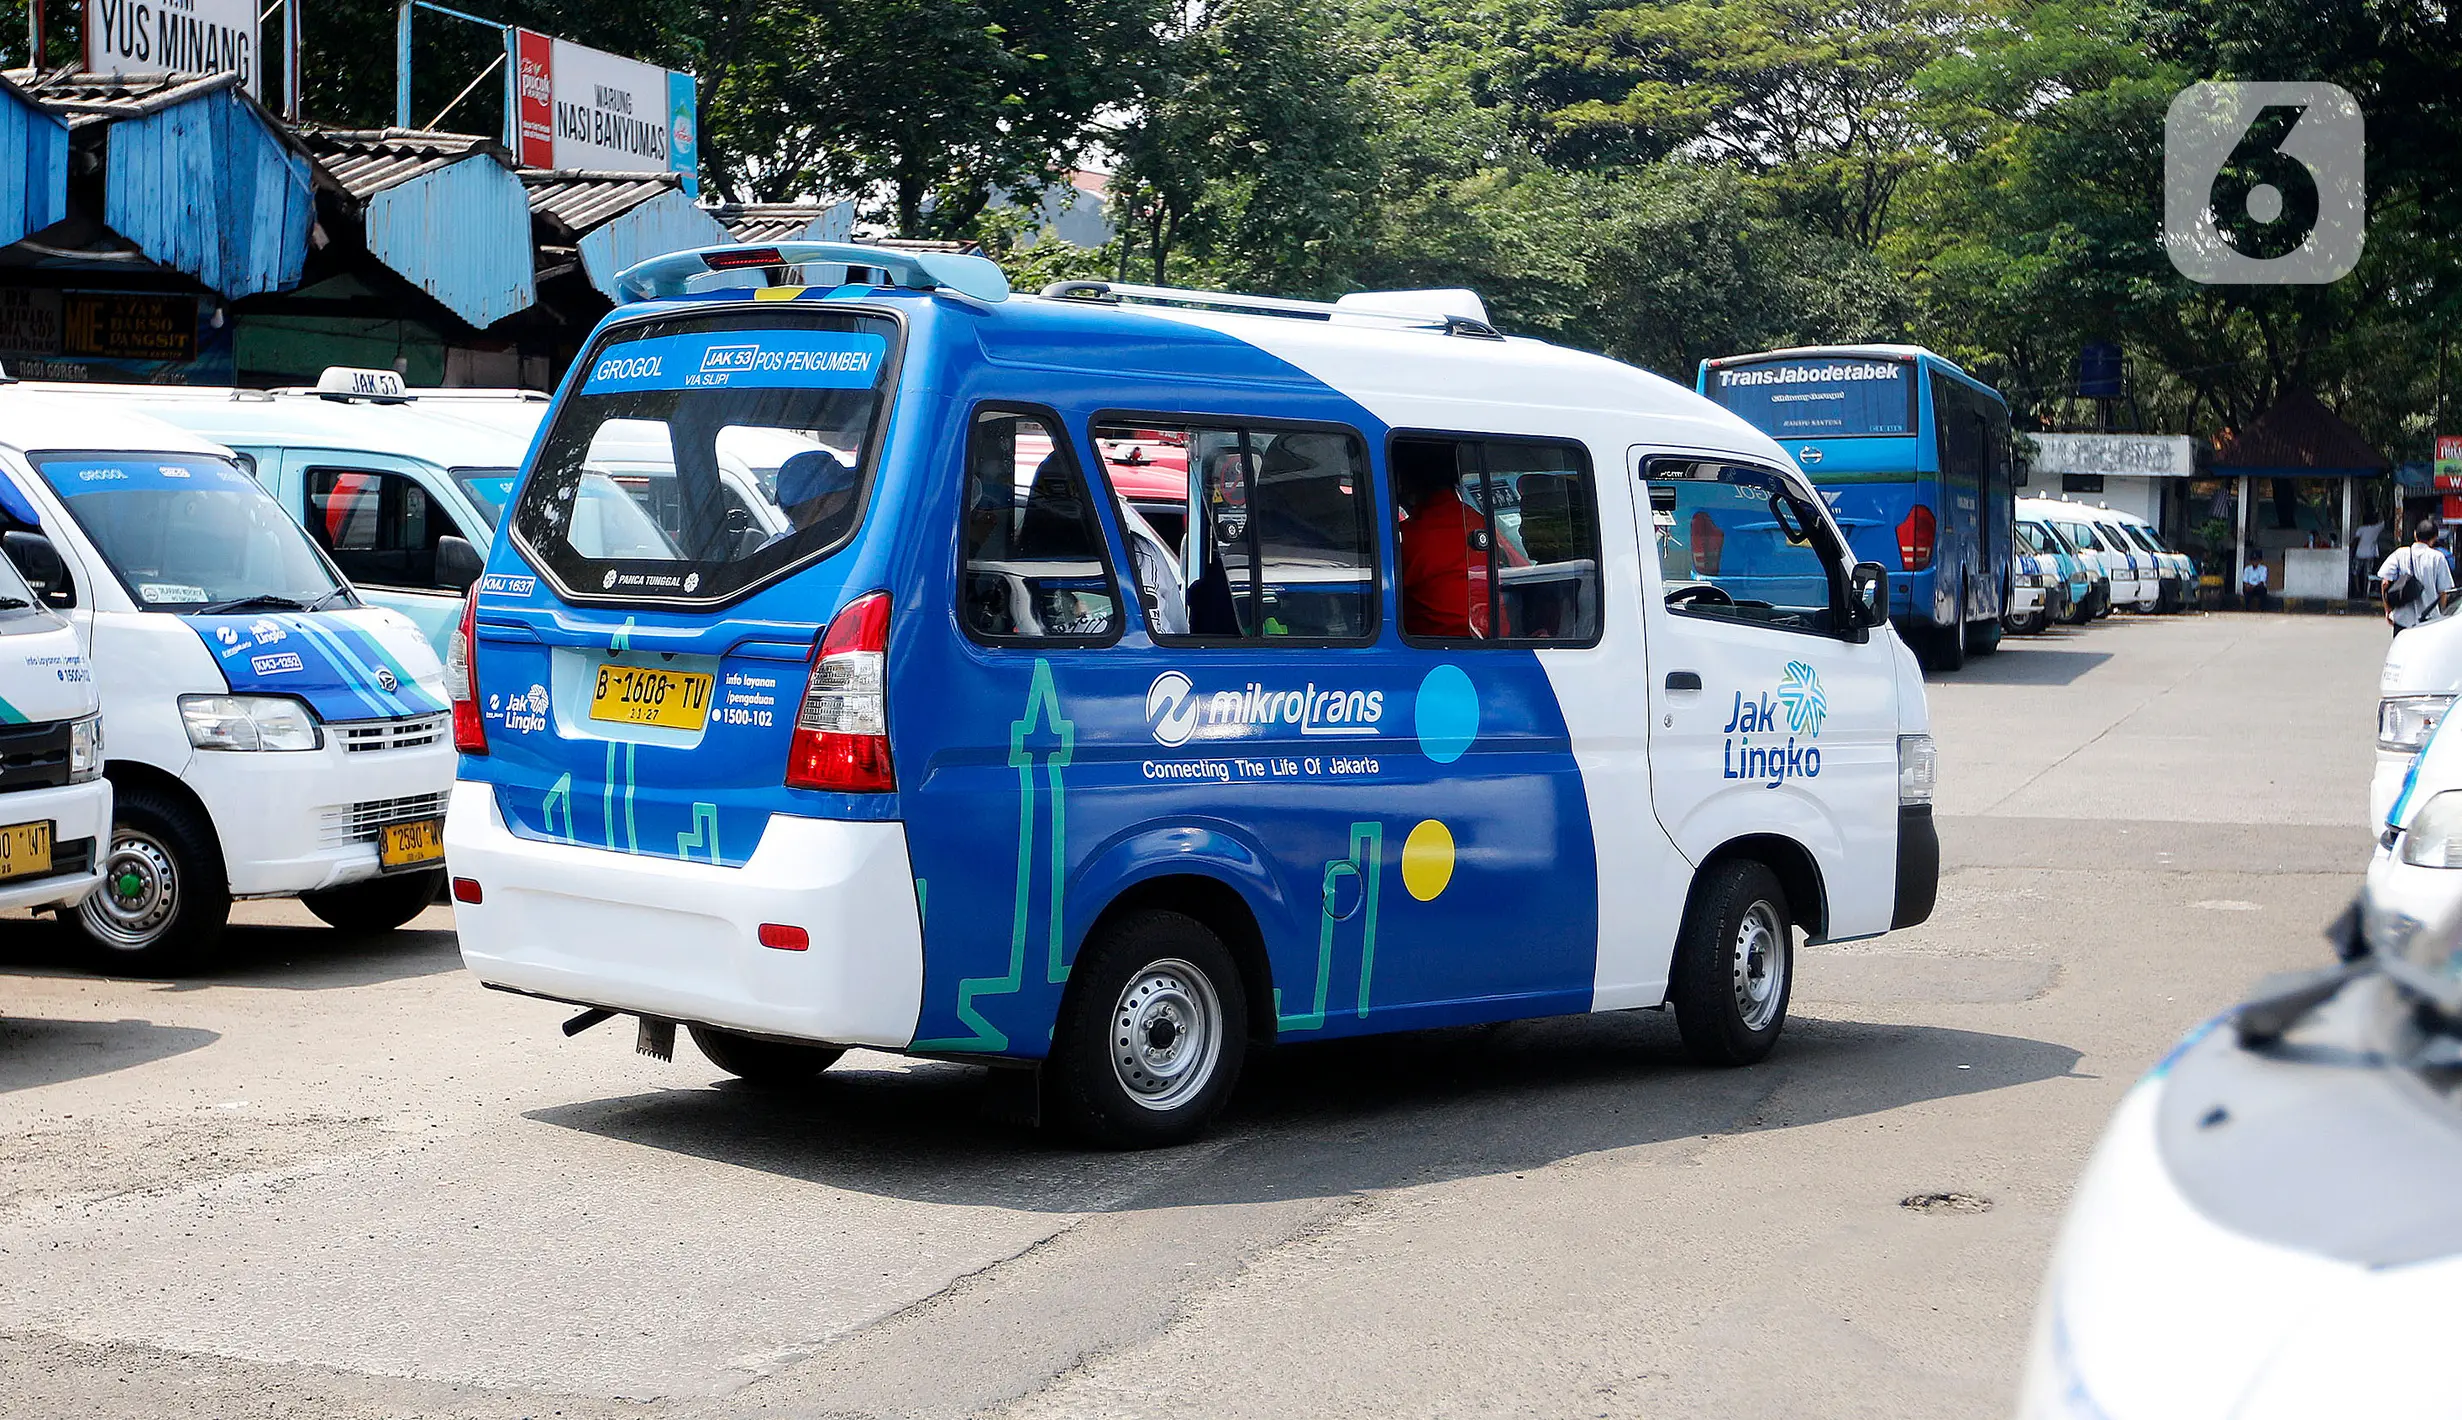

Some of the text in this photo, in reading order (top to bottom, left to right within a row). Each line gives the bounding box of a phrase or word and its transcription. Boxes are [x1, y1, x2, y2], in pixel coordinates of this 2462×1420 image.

[101, 0, 249, 88] YUS MINANG
[594, 83, 632, 115] WARUNG
[558, 101, 665, 161] NASI BANYUMAS
[597, 356, 662, 380] GROGOL
[705, 351, 751, 366] JAK 53
[754, 352, 872, 371] POS PENGUMBEN
[352, 373, 398, 395] JAK 53
[685, 373, 729, 386] VIA SLIPI
[1719, 363, 1900, 387] TransJabodetabek
[484, 577, 533, 592] KMJ 1637
[618, 575, 681, 587] PANCA TUNGGAL
[596, 669, 707, 709] B 1608 TV
[726, 673, 776, 690] info layanan
[506, 693, 528, 712] Jak
[726, 690, 775, 706] /pengaduan
[1208, 682, 1384, 735] mikrotrans
[505, 711, 546, 735] Lingko
[723, 708, 773, 727] 1500-102
[1723, 690, 1777, 734] Jak
[1143, 756, 1379, 782] Connecting The Life Of Jakarta
[1723, 736, 1821, 790] Lingko
[398, 827, 423, 851] 2590
